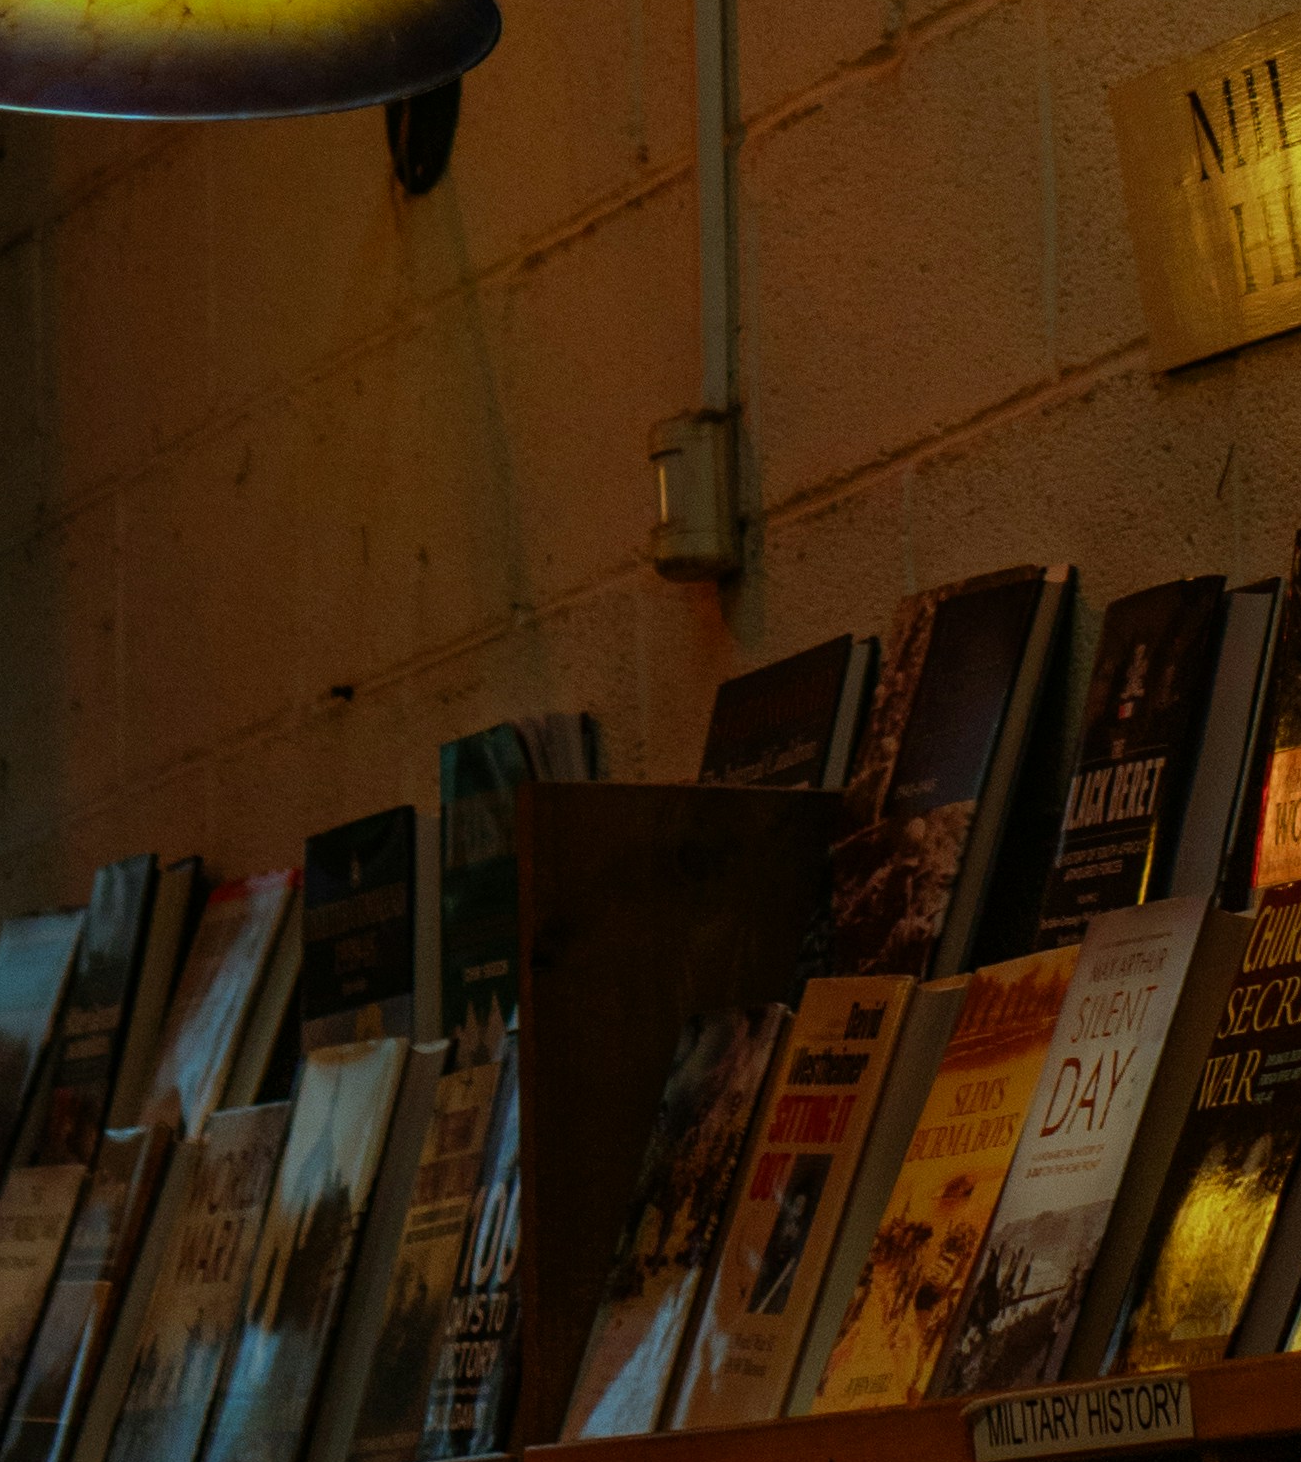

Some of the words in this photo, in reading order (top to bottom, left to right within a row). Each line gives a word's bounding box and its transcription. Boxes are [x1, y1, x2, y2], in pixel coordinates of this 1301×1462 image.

[1107, 756, 1167, 823] BERET
[843, 1000, 887, 1041] David
[1071, 984, 1158, 1044] SILENT
[1040, 1046, 1137, 1139] DAY
[1197, 1049, 1263, 1112] WAR
[986, 1396, 1080, 1449] MILITARY
[1087, 1383, 1187, 1438] HISTORY
